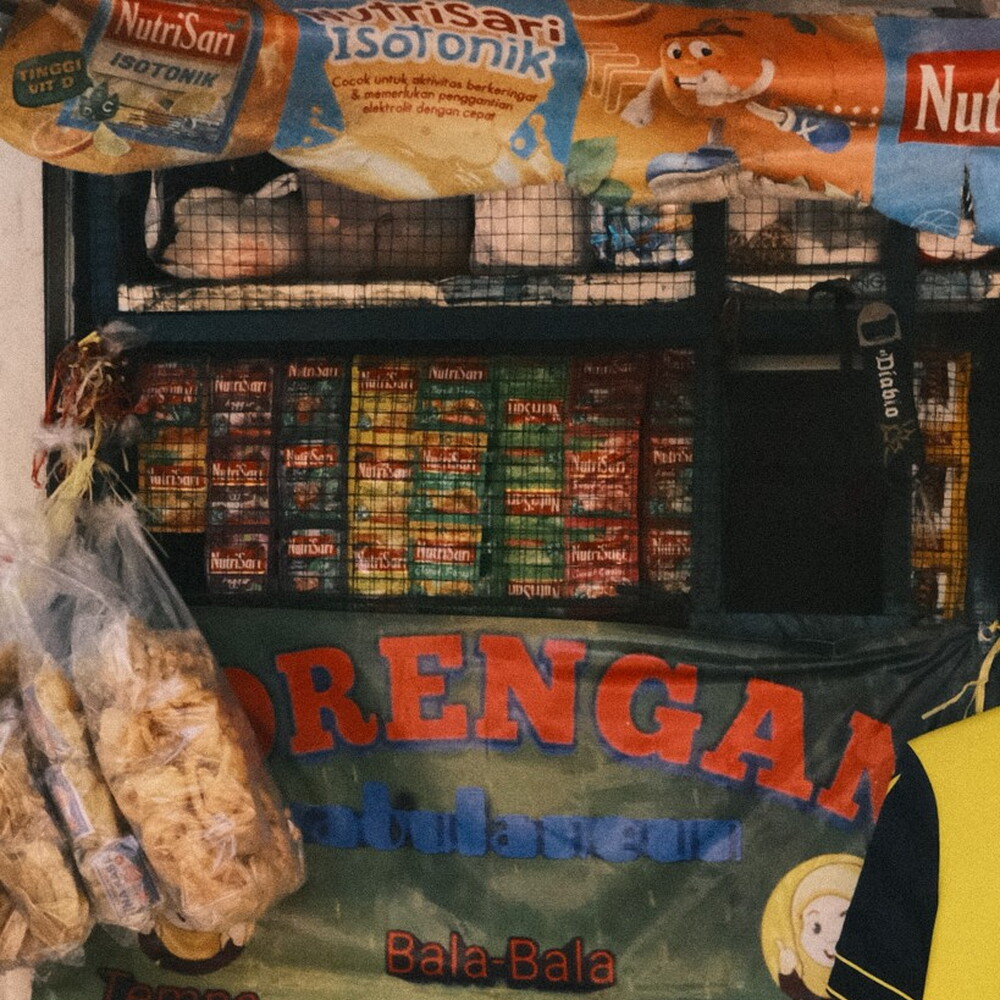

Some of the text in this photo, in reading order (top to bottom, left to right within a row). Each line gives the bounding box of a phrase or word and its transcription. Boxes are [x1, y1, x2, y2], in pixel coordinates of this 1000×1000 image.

[115, 0, 235, 57] NutriSari
[19, 59, 82, 82] TINGGI
[109, 52, 220, 87] ISOTONIK
[28, 76, 74, 94] VIT D
[332, 73, 538, 104] Cocok untuk aktivitas berkeringat
[351, 88, 514, 112] & memerlukan penggantian
[362, 102, 496, 122] elektrolit dengan cepat
[429, 365, 485, 381] NutriSari
[212, 461, 264, 478] NutriSari
[211, 551, 262, 570] NutriSari
[387, 930, 615, 984] Bala-Bala
